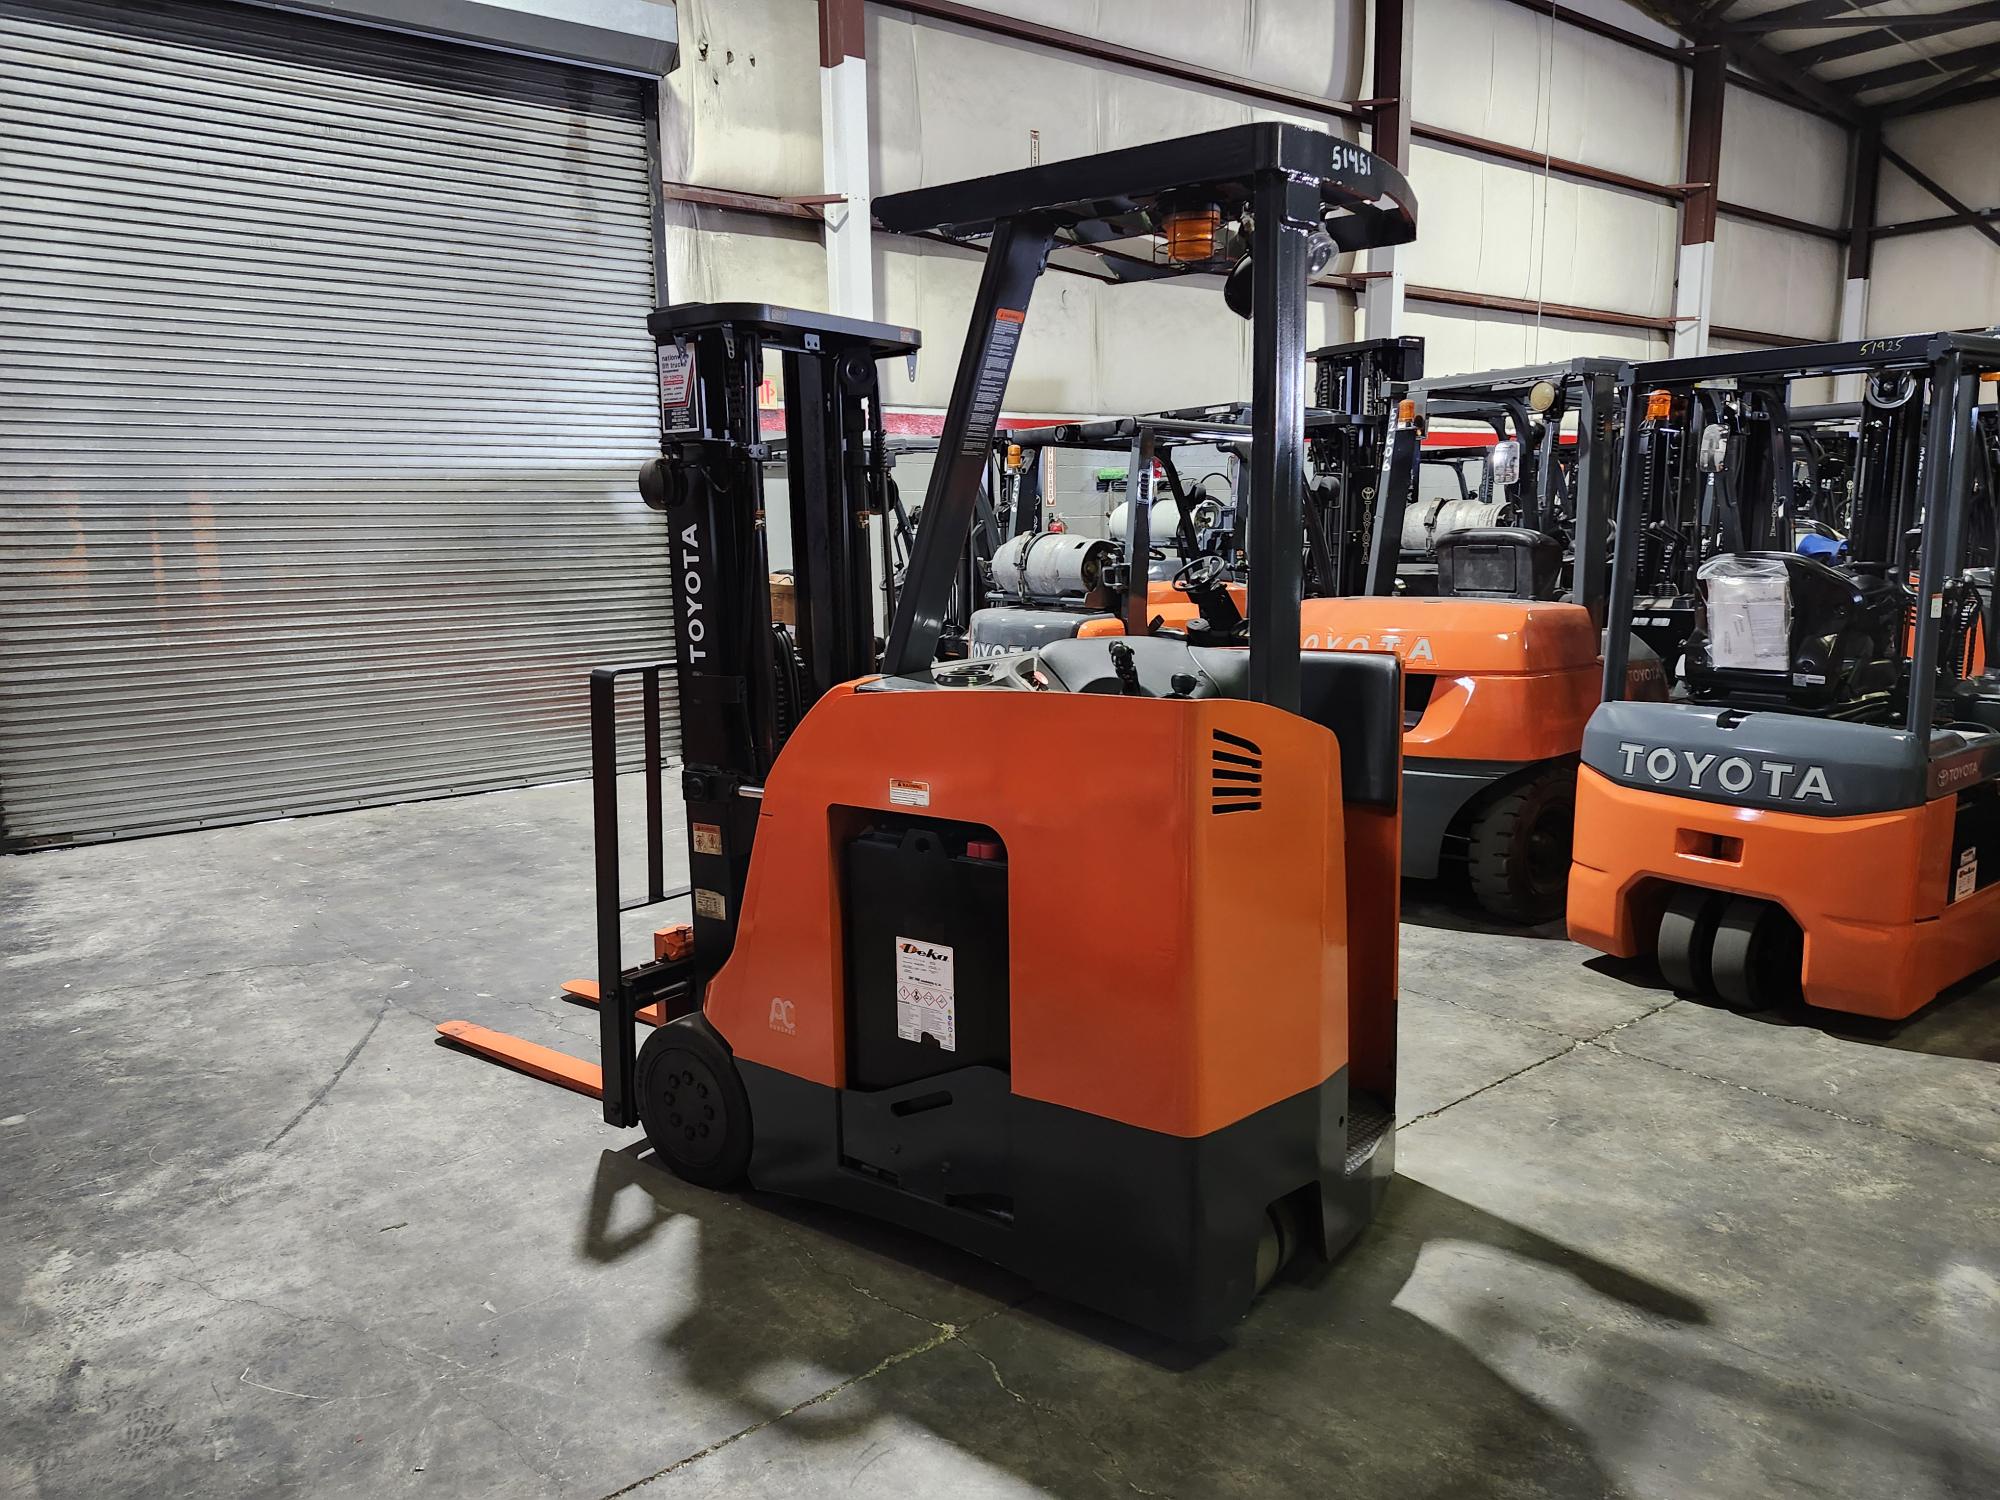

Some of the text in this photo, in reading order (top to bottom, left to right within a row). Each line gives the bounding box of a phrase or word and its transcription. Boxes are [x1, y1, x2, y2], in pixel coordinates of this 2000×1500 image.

[1332, 145, 1371, 175] 51451
[1860, 339, 1903, 356] 51925
[1382, 407, 1397, 472] 52606
[1360, 501, 1371, 565] TOYOTA
[681, 523, 706, 664] TOYOTA
[1619, 742, 1836, 803] TOYOTA
[1949, 761, 1978, 781] TOYOTA
[899, 943, 949, 962] Deka
